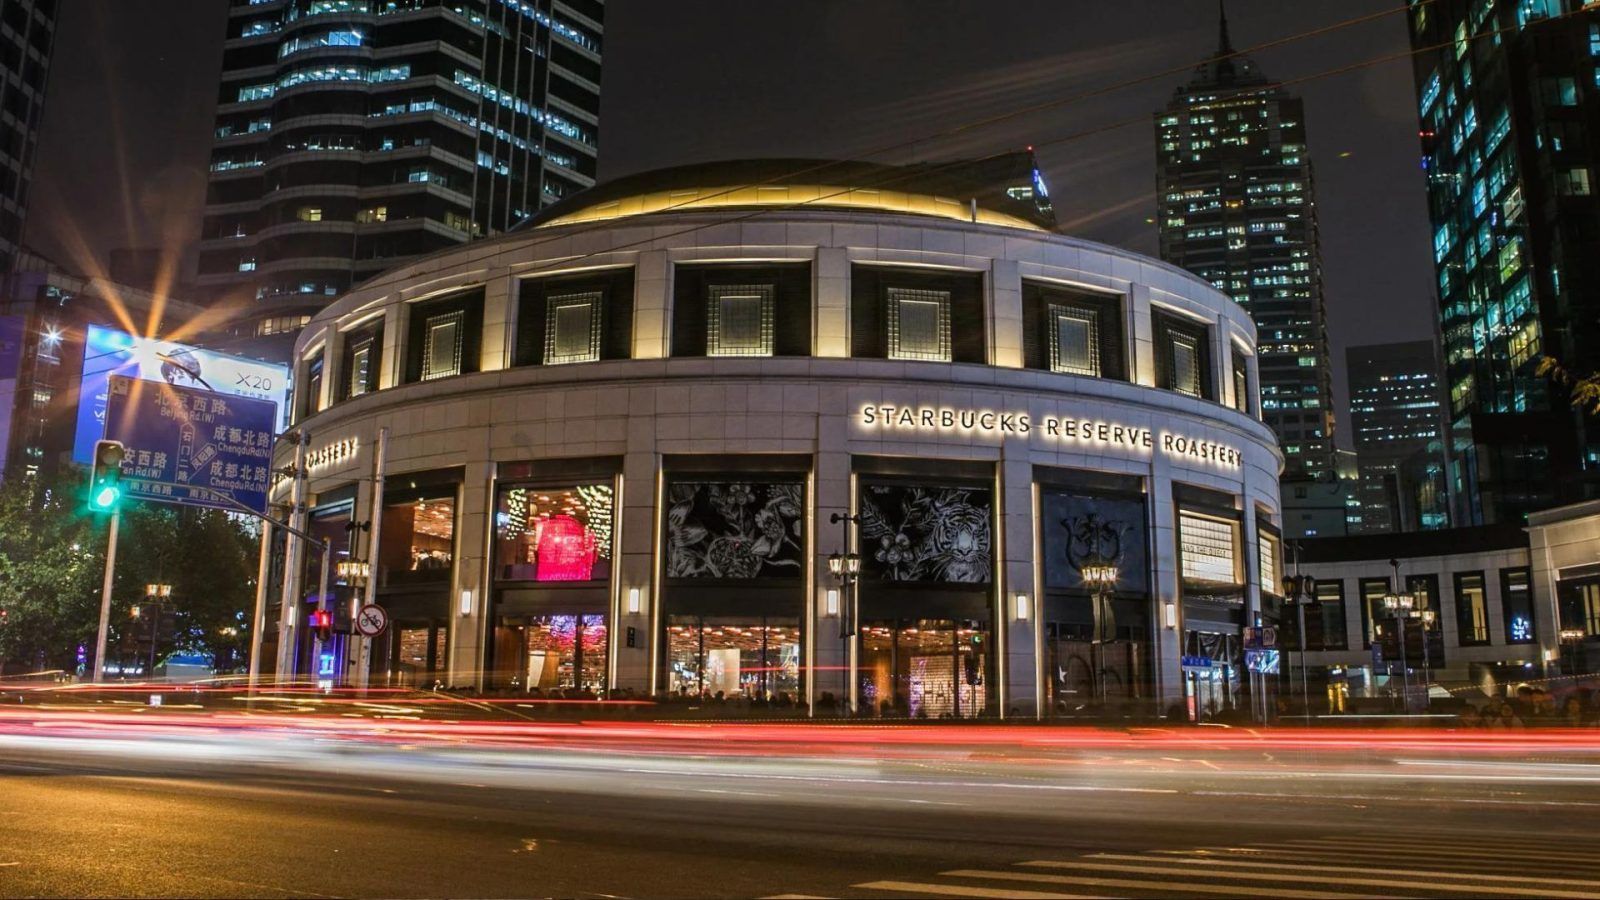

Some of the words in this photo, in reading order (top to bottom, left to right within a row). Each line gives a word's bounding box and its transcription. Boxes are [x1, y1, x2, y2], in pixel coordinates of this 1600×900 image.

[236, 373, 272, 391] X20
[154, 392, 227, 416] 北京西路
[213, 425, 270, 448] 成都北路
[863, 406, 1031, 432] STARBUCKS
[1046, 418, 1153, 447] RESERVE
[1163, 434, 1243, 467] ROASTERY
[209, 460, 267, 483] 成都北路
